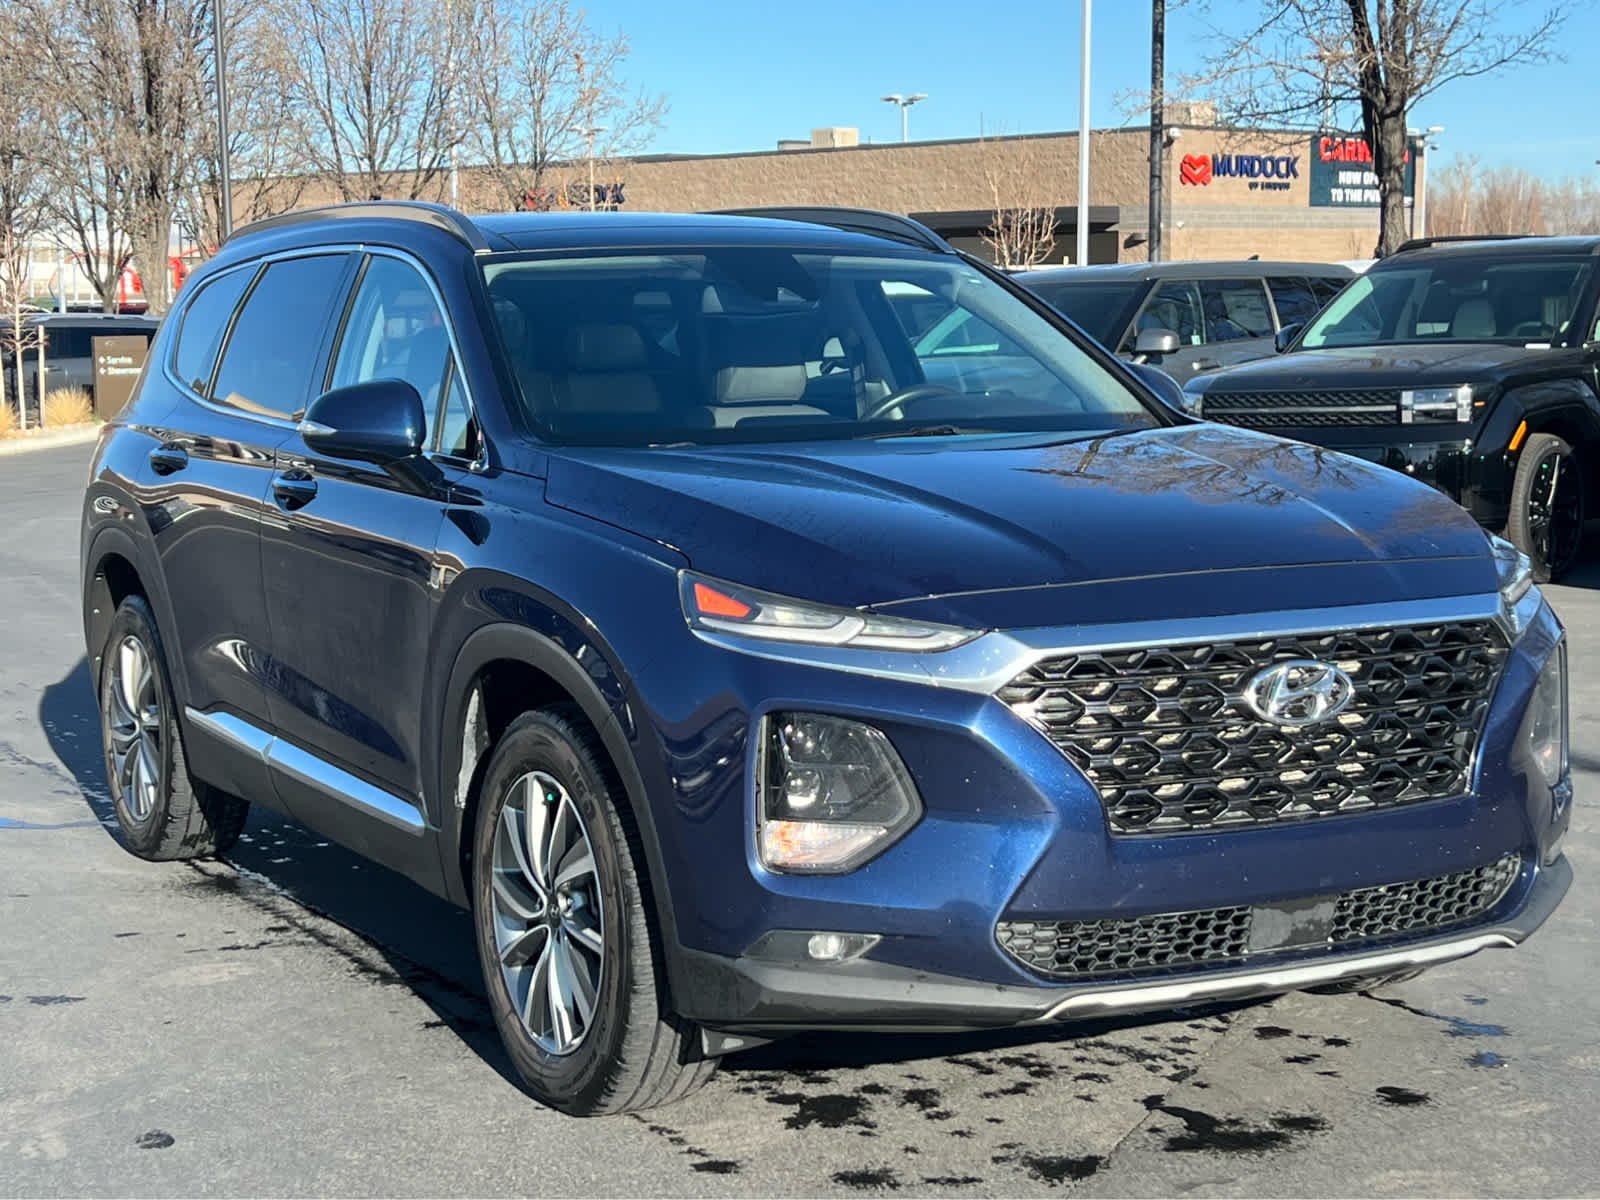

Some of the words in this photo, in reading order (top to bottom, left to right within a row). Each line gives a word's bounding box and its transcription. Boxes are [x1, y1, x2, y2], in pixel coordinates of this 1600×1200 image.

[1212, 154, 1299, 178] MURDOCK
[1338, 171, 1362, 185] NOW
[1330, 188, 1343, 202] TO
[1344, 188, 1363, 202] THE
